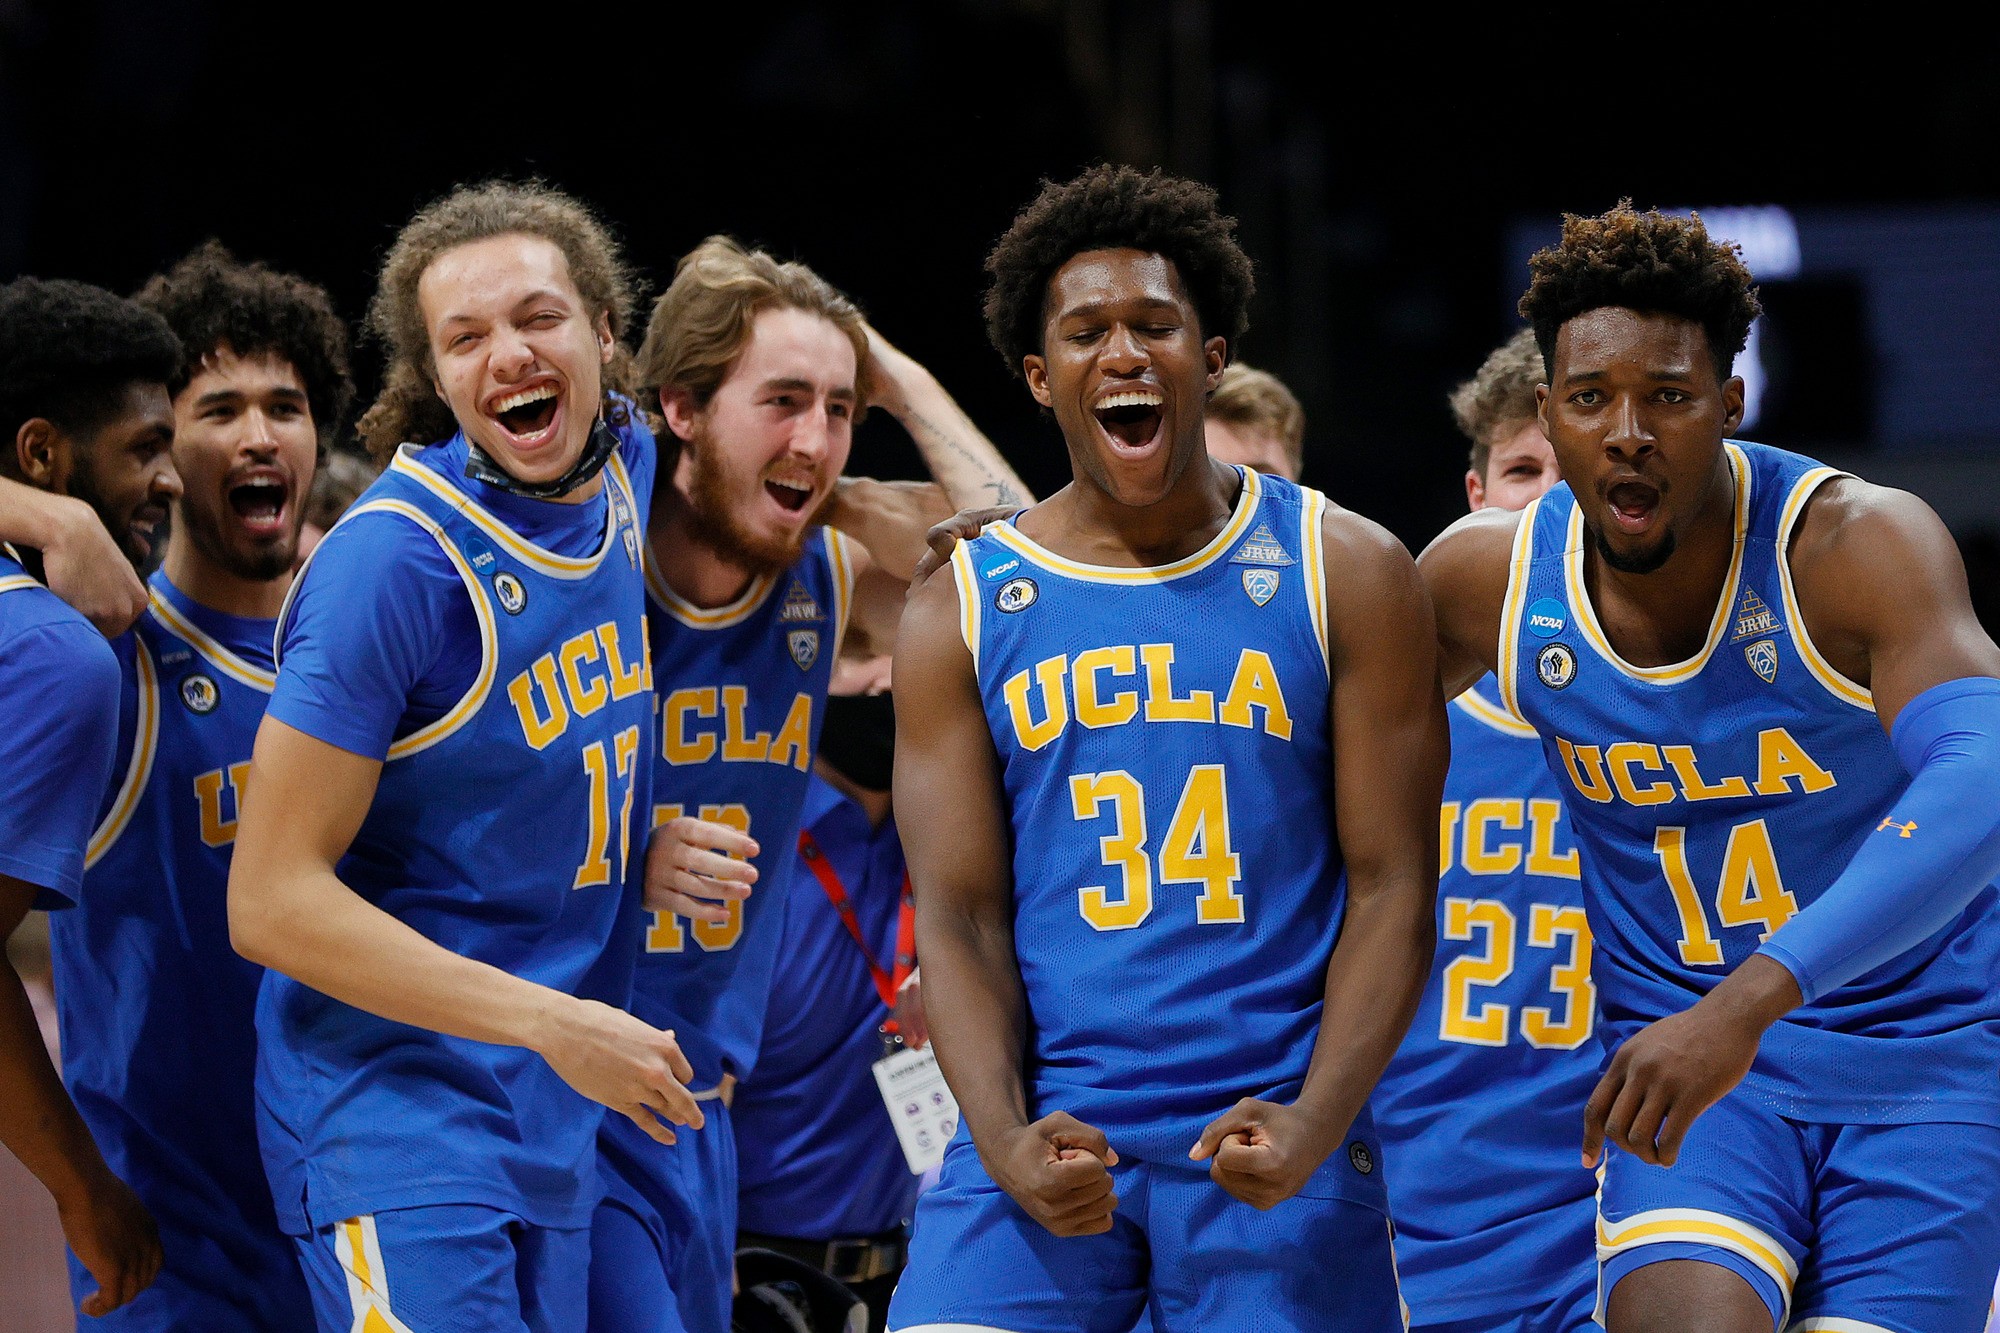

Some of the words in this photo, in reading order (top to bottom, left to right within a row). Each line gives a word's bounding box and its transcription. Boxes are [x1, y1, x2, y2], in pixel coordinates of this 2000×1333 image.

[473, 551, 495, 569] NCAA
[986, 559, 1019, 579] NCAA
[1241, 546, 1281, 560] JRW
[1252, 583, 1269, 598] 12
[1530, 614, 1564, 630] NCAA
[1738, 613, 1771, 635] JRW
[1757, 658, 1773, 676] 12
[1002, 643, 1293, 752] UCLA
[652, 685, 814, 773] CLA
[1556, 727, 1838, 806] UCLA
[1068, 763, 1245, 932] 34
[1439, 797, 1581, 881] CL
[1653, 818, 1799, 966] 14
[1439, 896, 1597, 1050] 23
